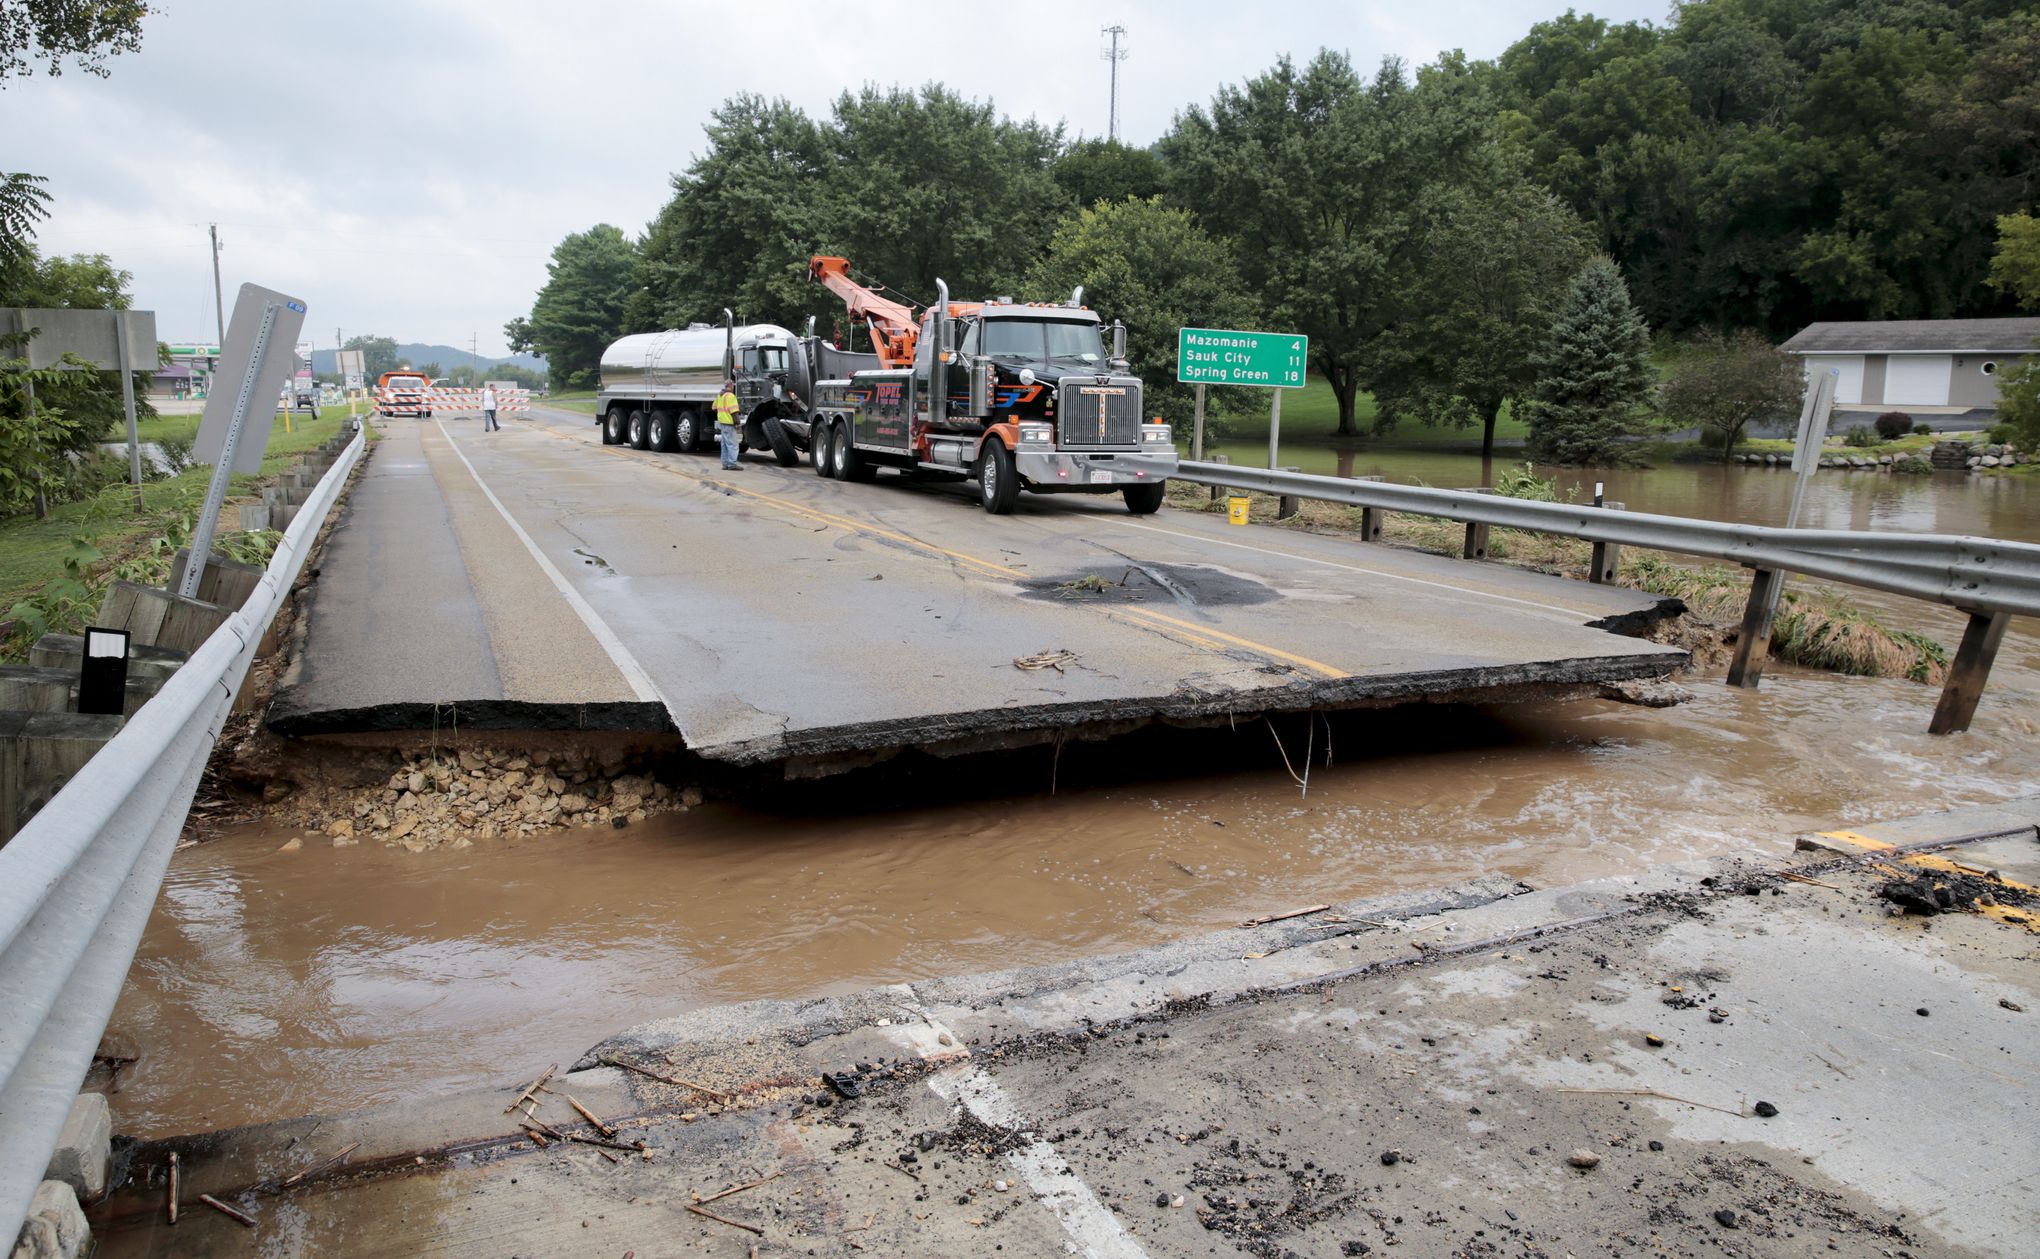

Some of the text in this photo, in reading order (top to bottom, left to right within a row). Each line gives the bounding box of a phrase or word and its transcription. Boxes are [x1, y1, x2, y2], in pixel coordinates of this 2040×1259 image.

[1186, 334, 1300, 351] Mazomanie 4
[1186, 350, 1300, 367] Sauk City 11
[1186, 365, 1299, 382] Spring Green 18
[875, 383, 902, 403] TOPEL
